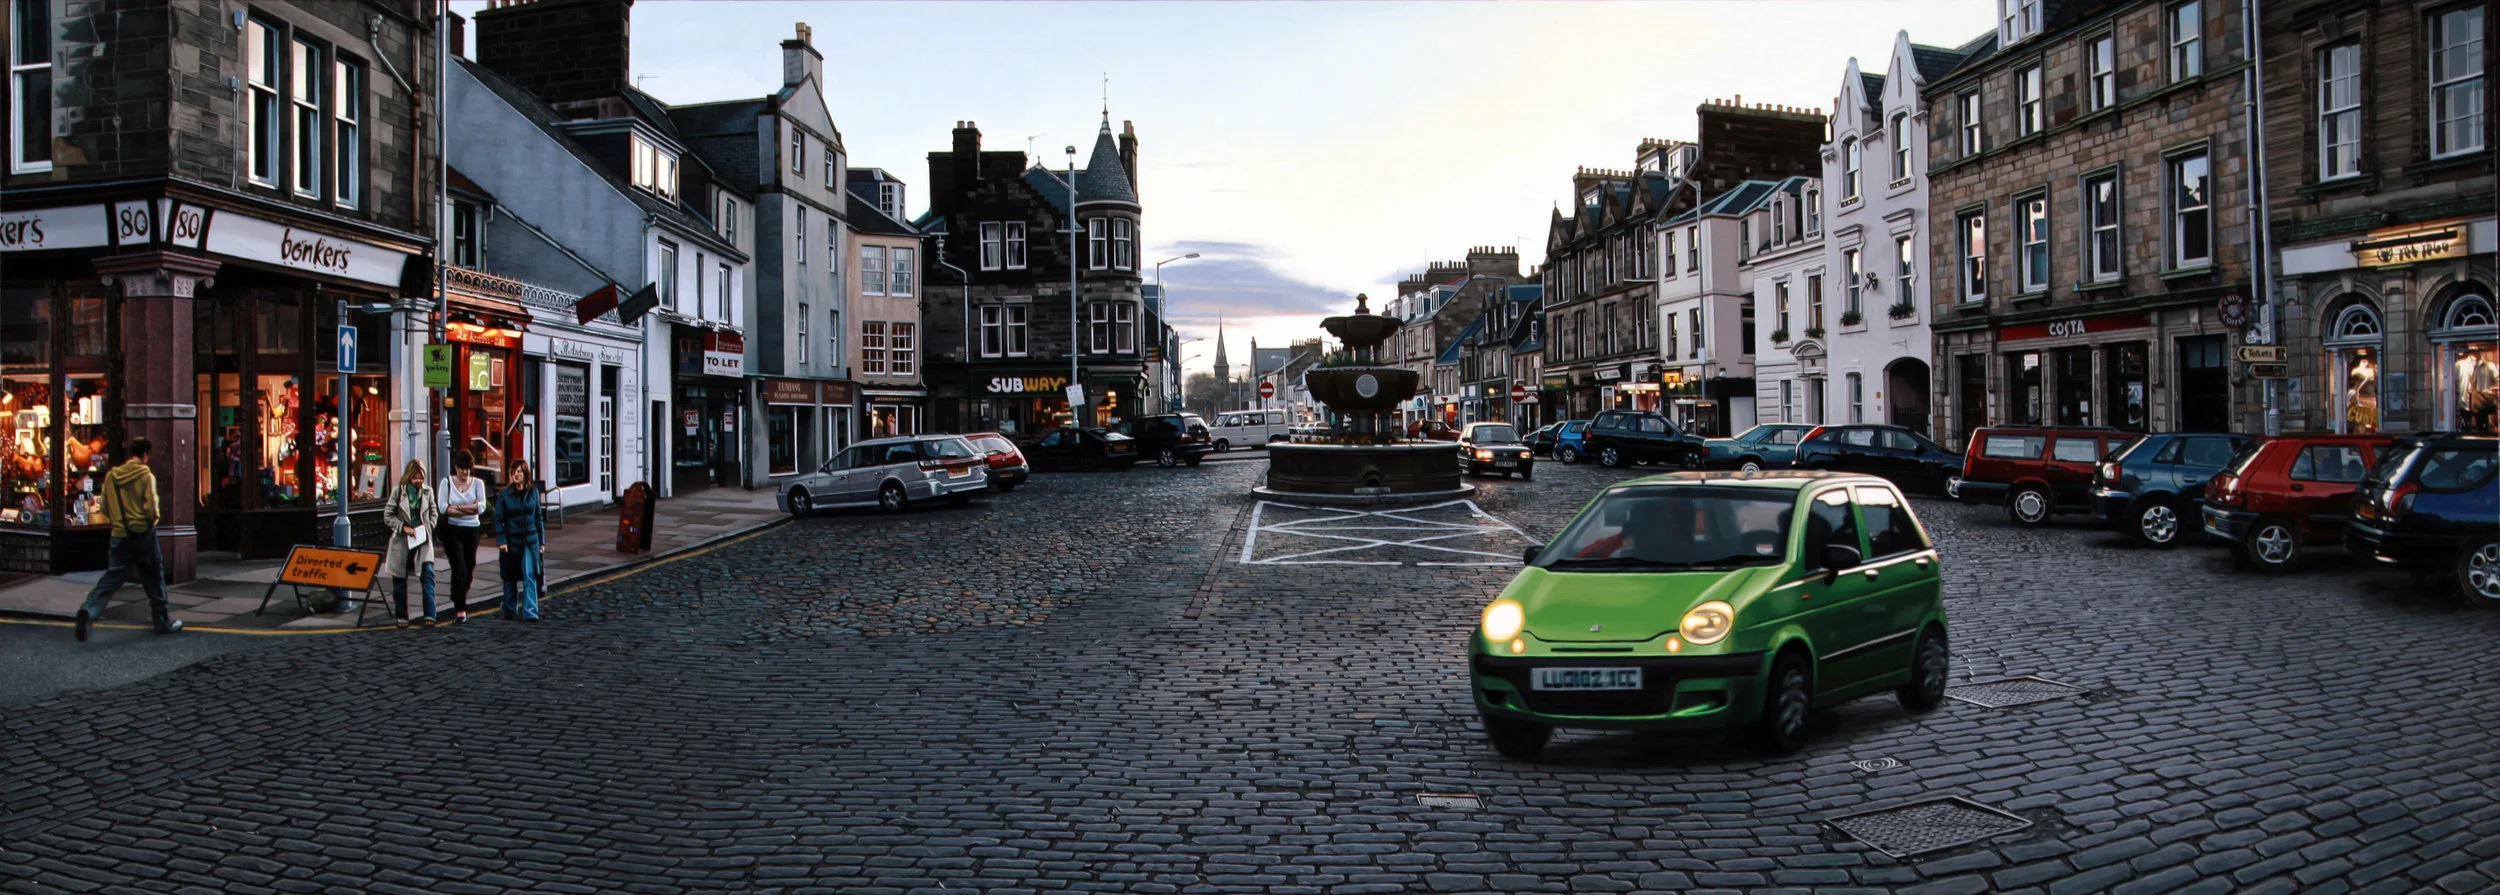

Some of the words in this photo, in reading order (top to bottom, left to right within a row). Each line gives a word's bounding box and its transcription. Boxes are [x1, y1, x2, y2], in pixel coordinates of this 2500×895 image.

[120, 208, 149, 237] 80
[176, 210, 200, 239] 80
[281, 227, 351, 270] bonkers
[2049, 319, 2085, 338] COSTA
[706, 357, 719, 367] TO
[722, 359, 740, 368] LET
[987, 377, 1066, 393] SUBWAY
[296, 555, 343, 569] Diverted
[291, 567, 328, 580] traffic
